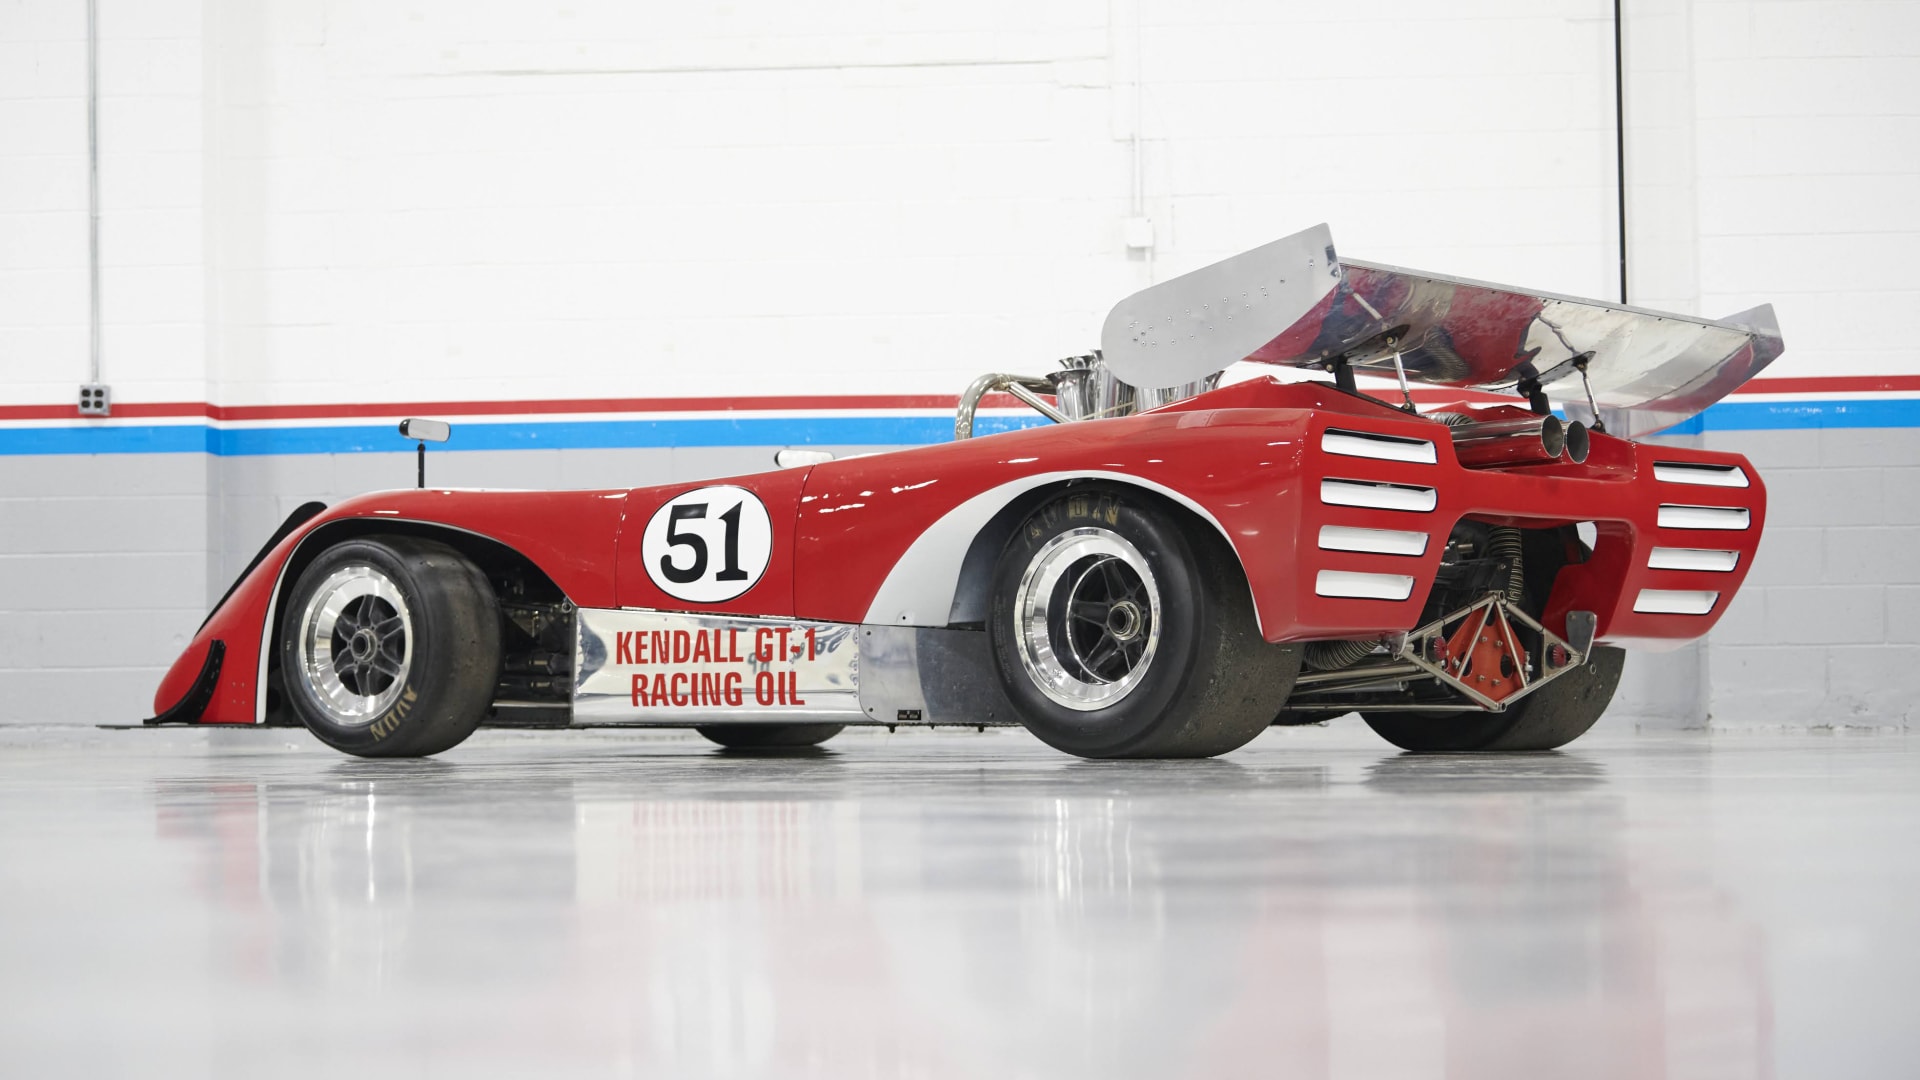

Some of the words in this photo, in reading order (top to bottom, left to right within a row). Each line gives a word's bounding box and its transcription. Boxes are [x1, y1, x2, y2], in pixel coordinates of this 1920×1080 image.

[660, 500, 749, 584] 51
[616, 630, 744, 665] KENDALL
[755, 627, 816, 663] GT-1
[369, 684, 418, 742] AVON
[631, 671, 743, 707] RACING
[755, 671, 805, 706] OIL
